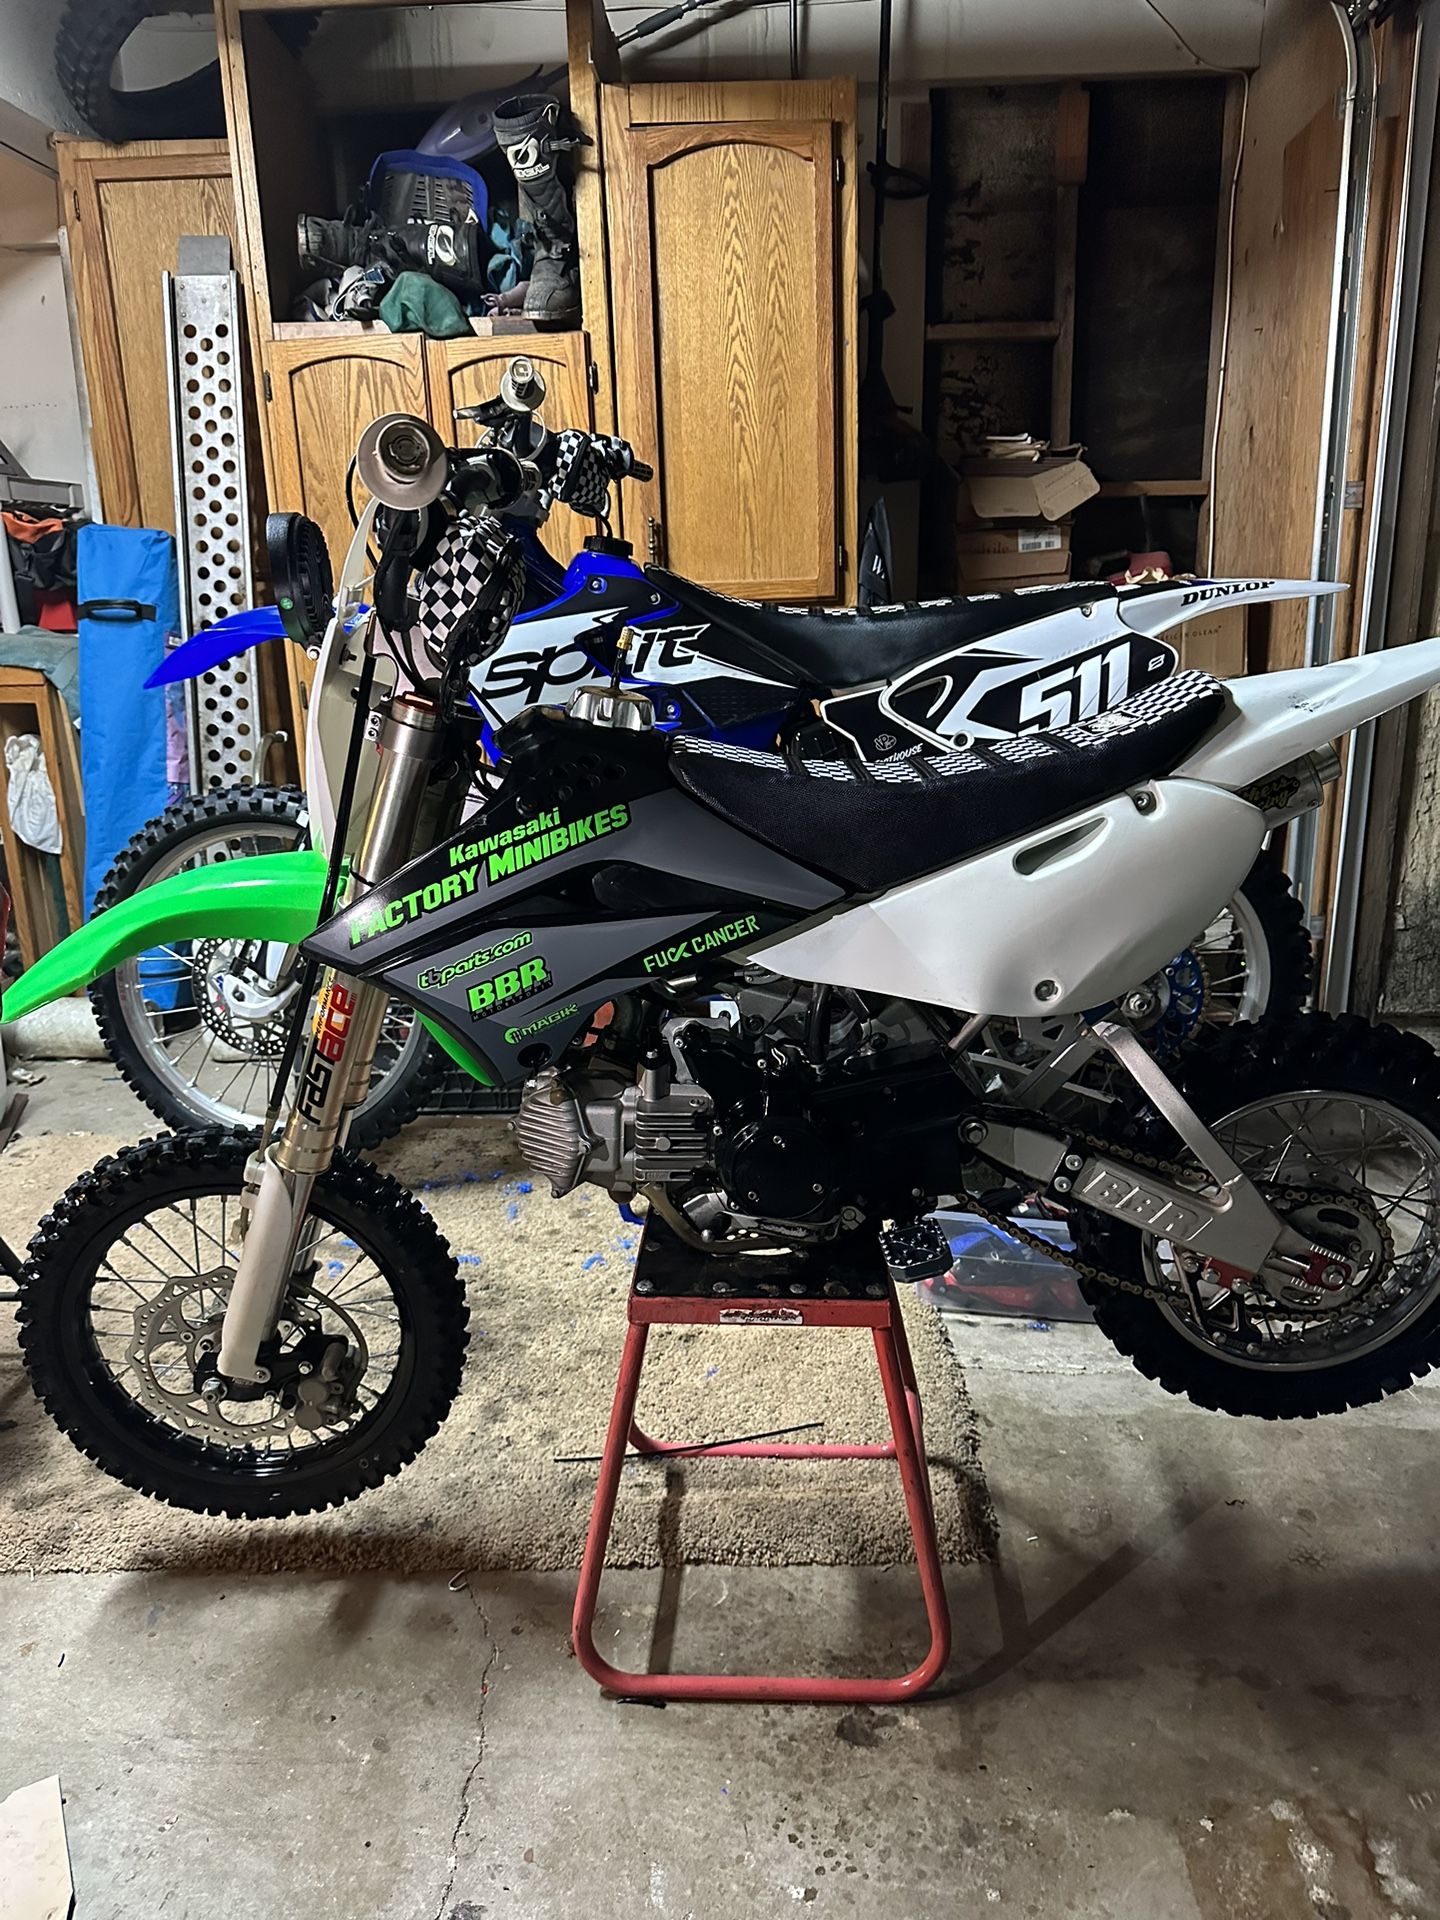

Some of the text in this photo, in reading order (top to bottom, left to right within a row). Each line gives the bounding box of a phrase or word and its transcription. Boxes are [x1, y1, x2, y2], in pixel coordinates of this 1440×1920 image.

[1181, 581, 1275, 606] DUNLOP
[482, 623, 711, 705] spit
[1019, 642, 1131, 733] 511
[449, 807, 561, 867] Kawasaki
[350, 804, 629, 945] FACTORY MINIBIKES
[418, 931, 533, 990] tbparts.com
[691, 914, 761, 953] CANCER
[315, 976, 335, 1040] PERFORMANCE
[468, 958, 547, 1012] BBR
